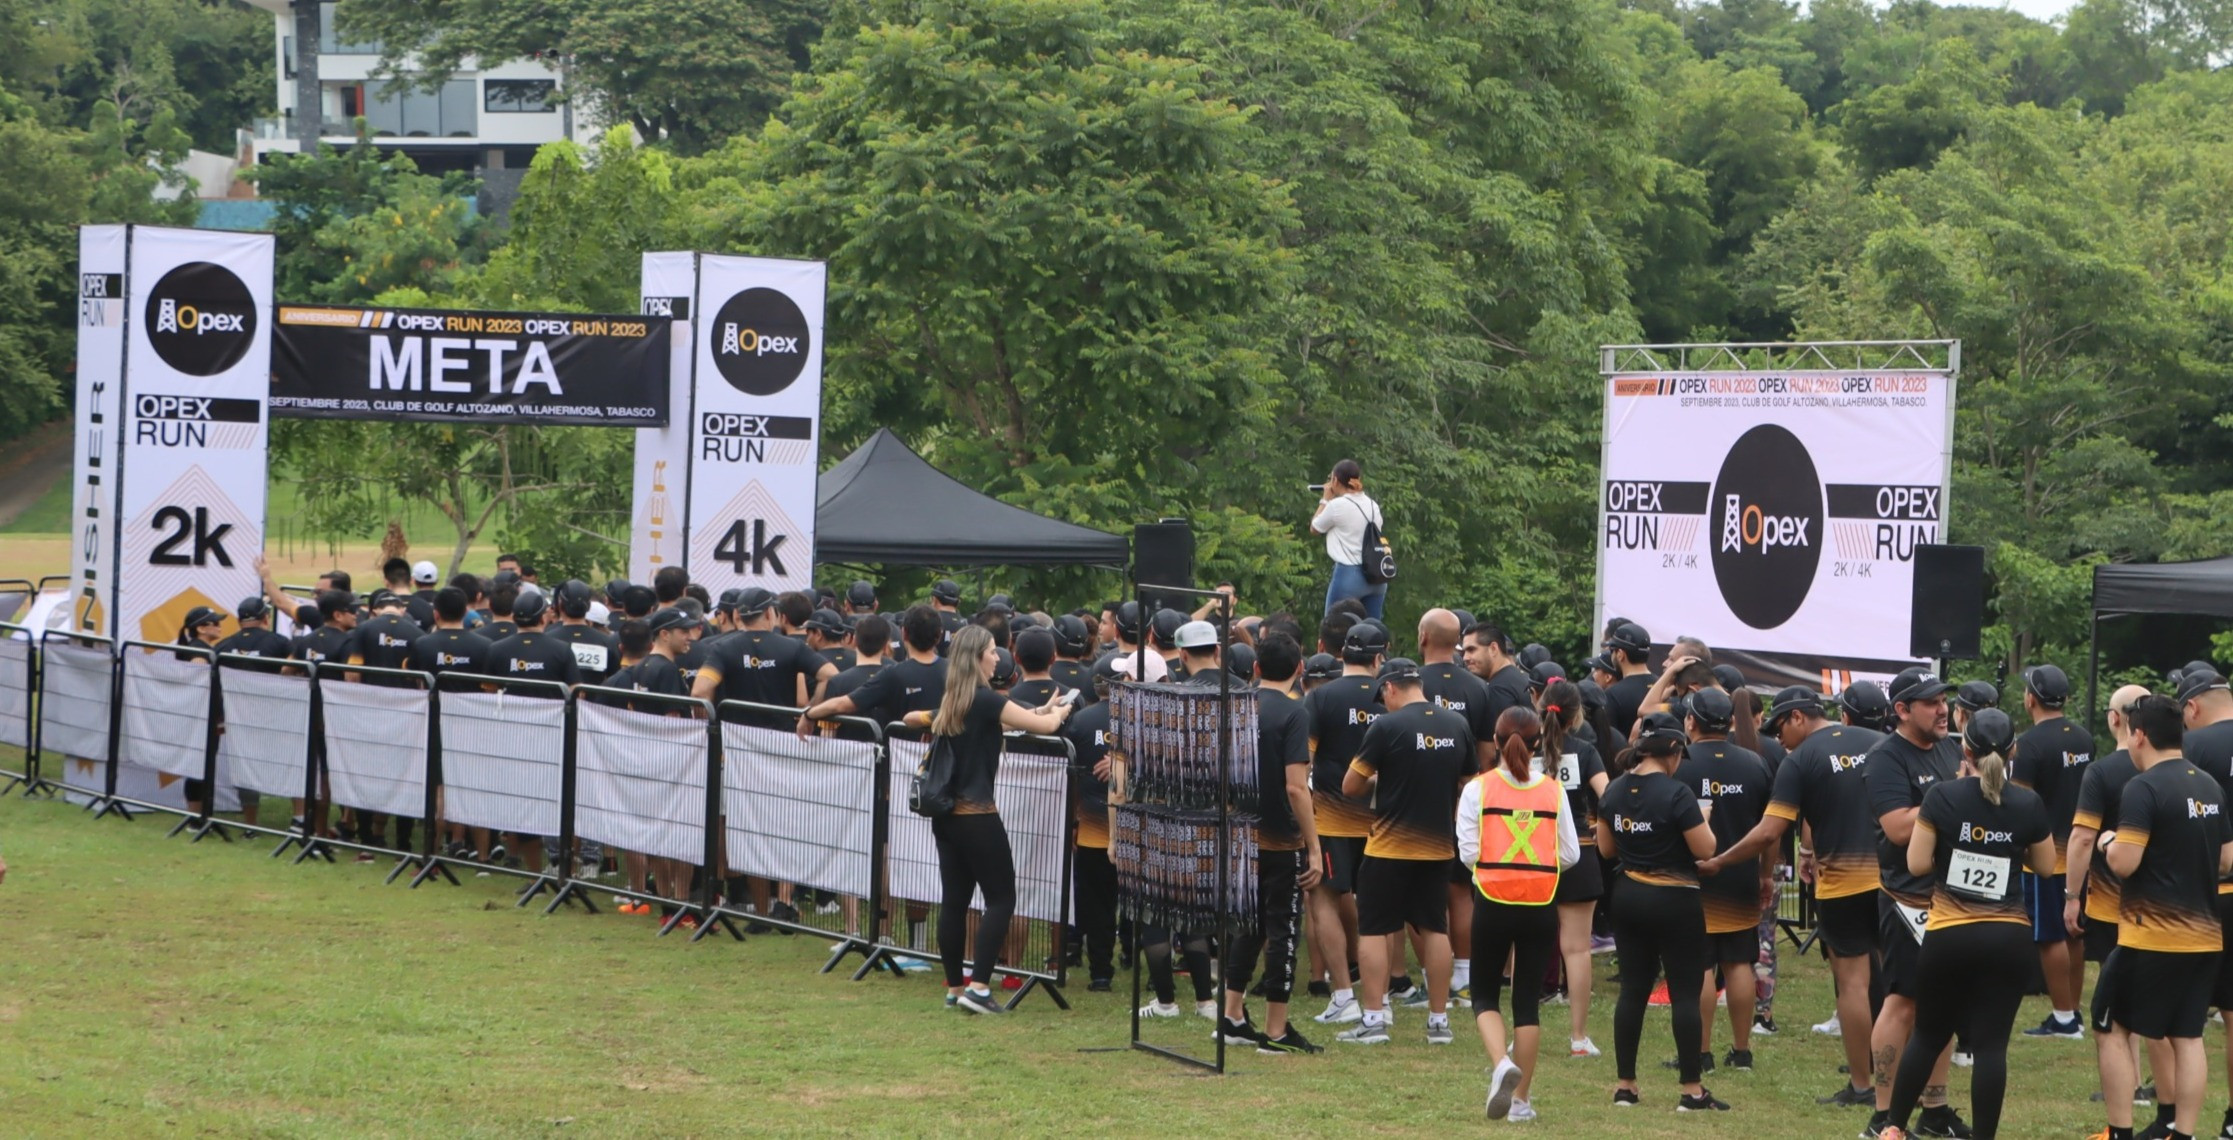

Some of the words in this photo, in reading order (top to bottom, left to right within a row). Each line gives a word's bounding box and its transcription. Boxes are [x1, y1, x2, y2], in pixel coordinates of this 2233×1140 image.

[83, 275, 107, 297] OPEX
[82, 301, 105, 327] RUN
[177, 305, 244, 334] Opex
[285, 311, 357, 324] ANIVERSARIO
[398, 315, 444, 331] OPEX
[447, 317, 483, 332] RUN
[486, 319, 522, 334] 2023
[525, 320, 570, 335] OPEX
[572, 322, 608, 336] RUN
[611, 323, 646, 337] 2023
[739, 329, 798, 356] Opex
[369, 334, 563, 395] META
[1679, 378, 1707, 394] OPEX
[1709, 379, 1731, 393] RUN
[1734, 378, 1756, 393] 2023
[1758, 378, 1787, 394] OPEX
[1789, 378, 1814, 393] RUN
[1815, 378, 1840, 393] 2023
[1841, 377, 1872, 393] OPEX
[1874, 377, 1899, 393] RUN
[1902, 376, 1927, 392] 2023
[138, 395, 212, 420] OPEX
[268, 397, 341, 410] SEPTIEMBRE
[342, 400, 371, 412] 2023,
[373, 400, 404, 411] CLUB
[407, 401, 422, 412] DE
[424, 402, 454, 413] GOLF
[456, 403, 517, 415] ALTOZANO,
[519, 405, 604, 417] VILLAHERMOSA,
[606, 406, 656, 418] TABASCO
[1680, 397, 1722, 408] SEPTIEMBRE
[1742, 397, 1761, 408] CLUB
[1762, 397, 1771, 407] DE
[1772, 397, 1791, 408] GOLF
[136, 420, 206, 448] RUN
[704, 413, 769, 437] OPEX
[702, 437, 764, 463] RUN
[82, 381, 105, 631] NISHER
[1608, 482, 1663, 511] OPEX
[1875, 487, 1938, 518] OPEX
[1606, 514, 1659, 551] RUN
[1742, 504, 1809, 555] Opex
[1662, 554, 1676, 569] 2K
[1684, 554, 1698, 569] 4K
[1833, 561, 1848, 577] 2K
[1857, 562, 1872, 578] 4K
[517, 659, 545, 672] Opex
[750, 656, 776, 669] Opex
[1441, 698, 1466, 710] Opex
[1424, 735, 1455, 750] Opex
[1840, 753, 1867, 769] Ope
[2068, 751, 2090, 765] Opex
[1560, 767, 1570, 782] 8
[1710, 781, 1743, 797] Opex
[2195, 800, 2220, 818] Opex
[1622, 817, 1653, 834] Opex
[1971, 826, 2013, 844] Opex
[1957, 852, 1975, 863] OPEX
[1962, 867, 1998, 890] 122
